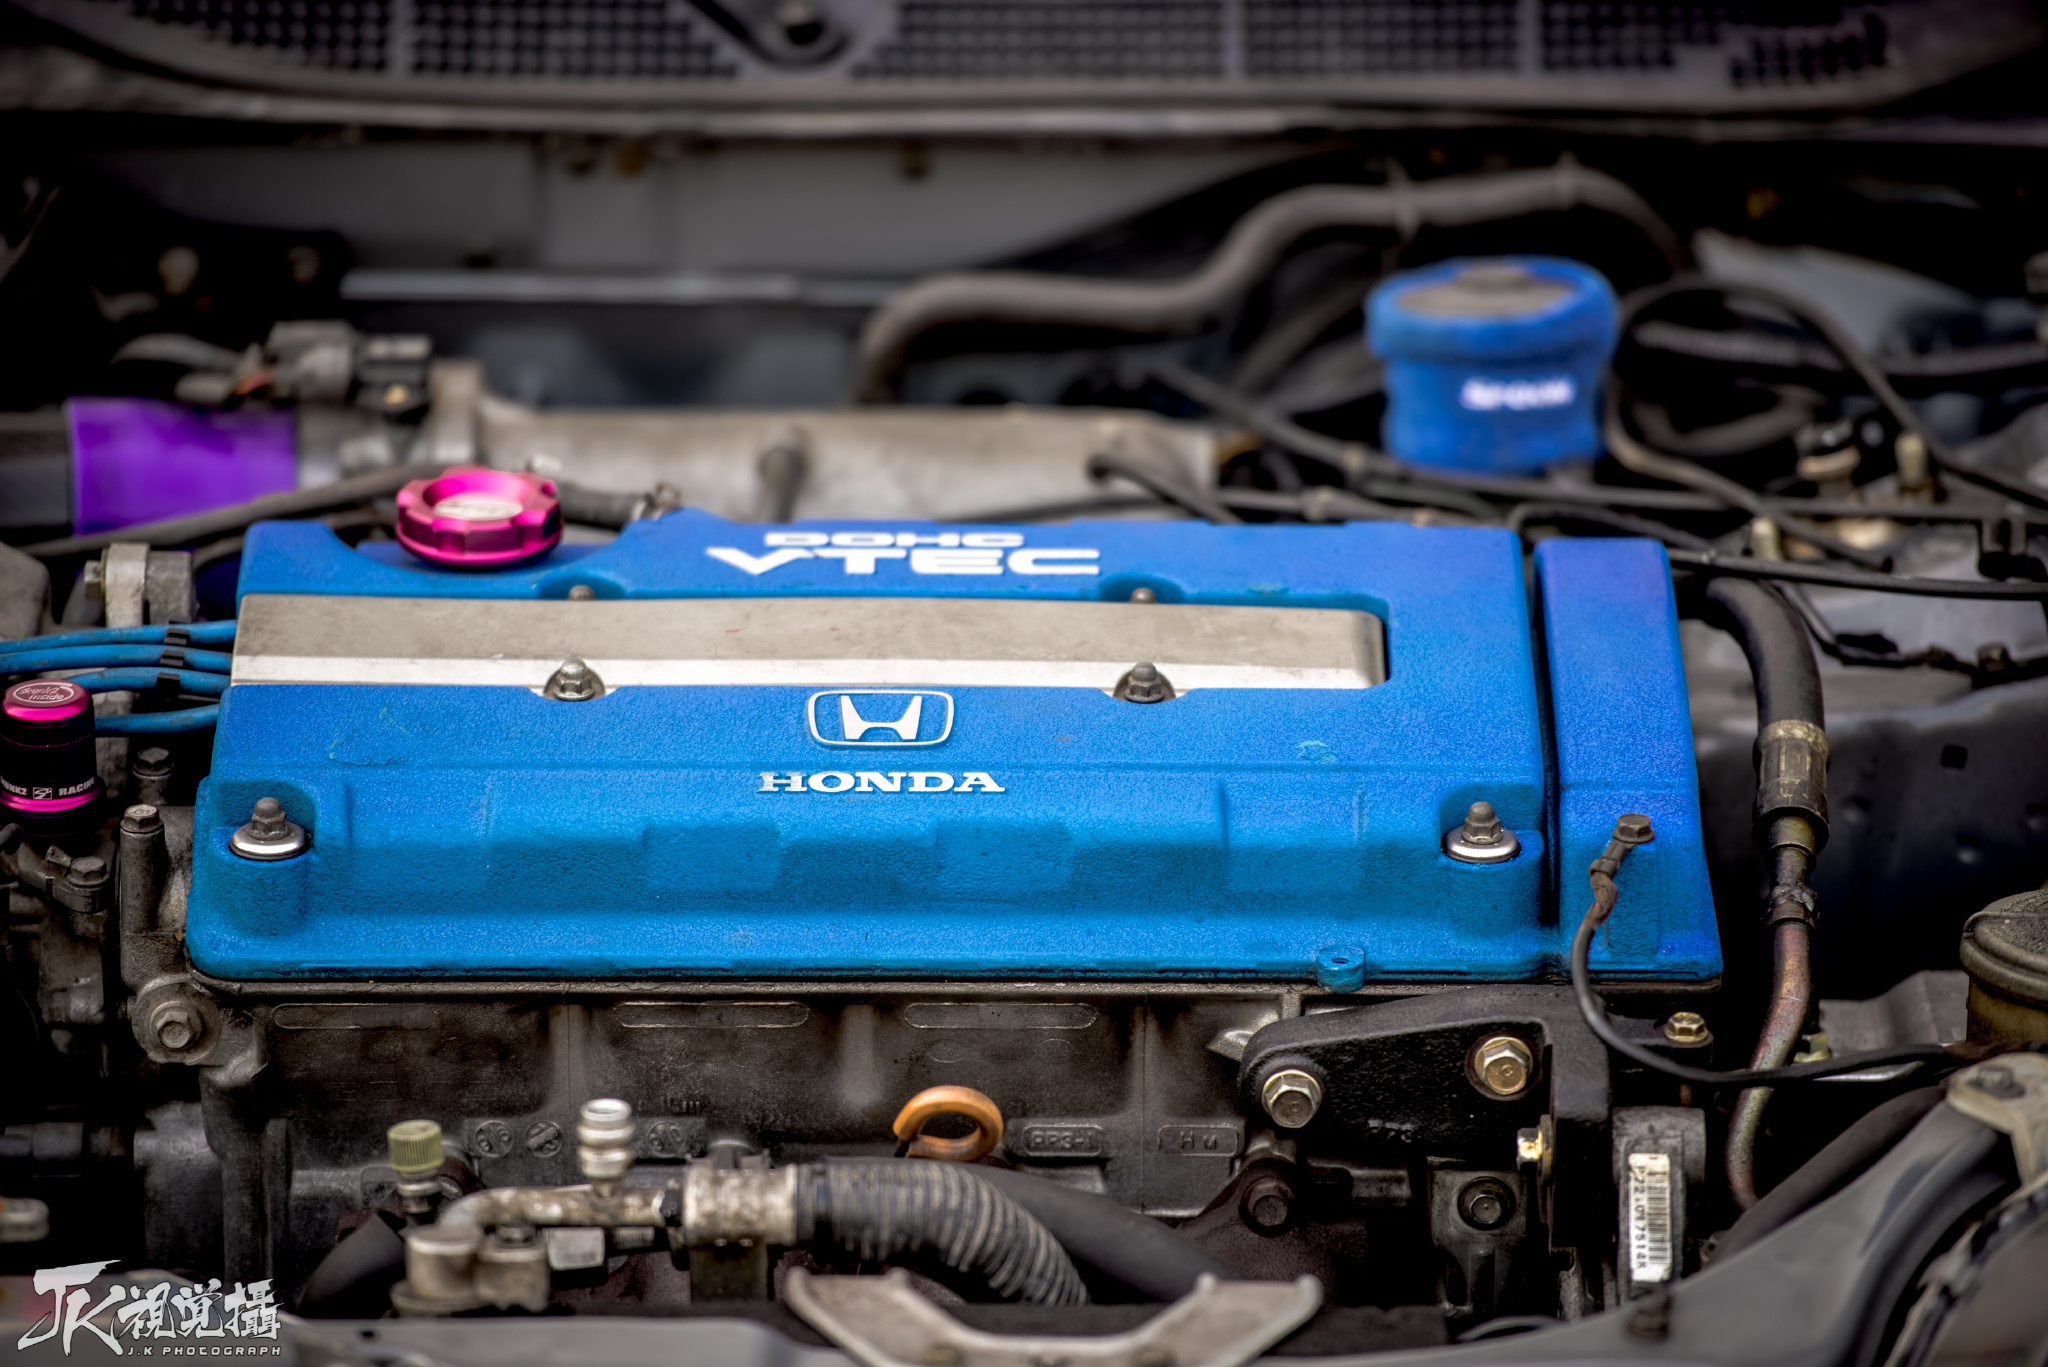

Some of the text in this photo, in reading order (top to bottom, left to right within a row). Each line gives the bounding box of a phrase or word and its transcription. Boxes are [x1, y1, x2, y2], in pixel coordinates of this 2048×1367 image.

[765, 532, 1025, 548] DOHC
[705, 547, 1101, 576] VTEC
[28, 693, 65, 701] inside
[757, 771, 1006, 793] HONDA
